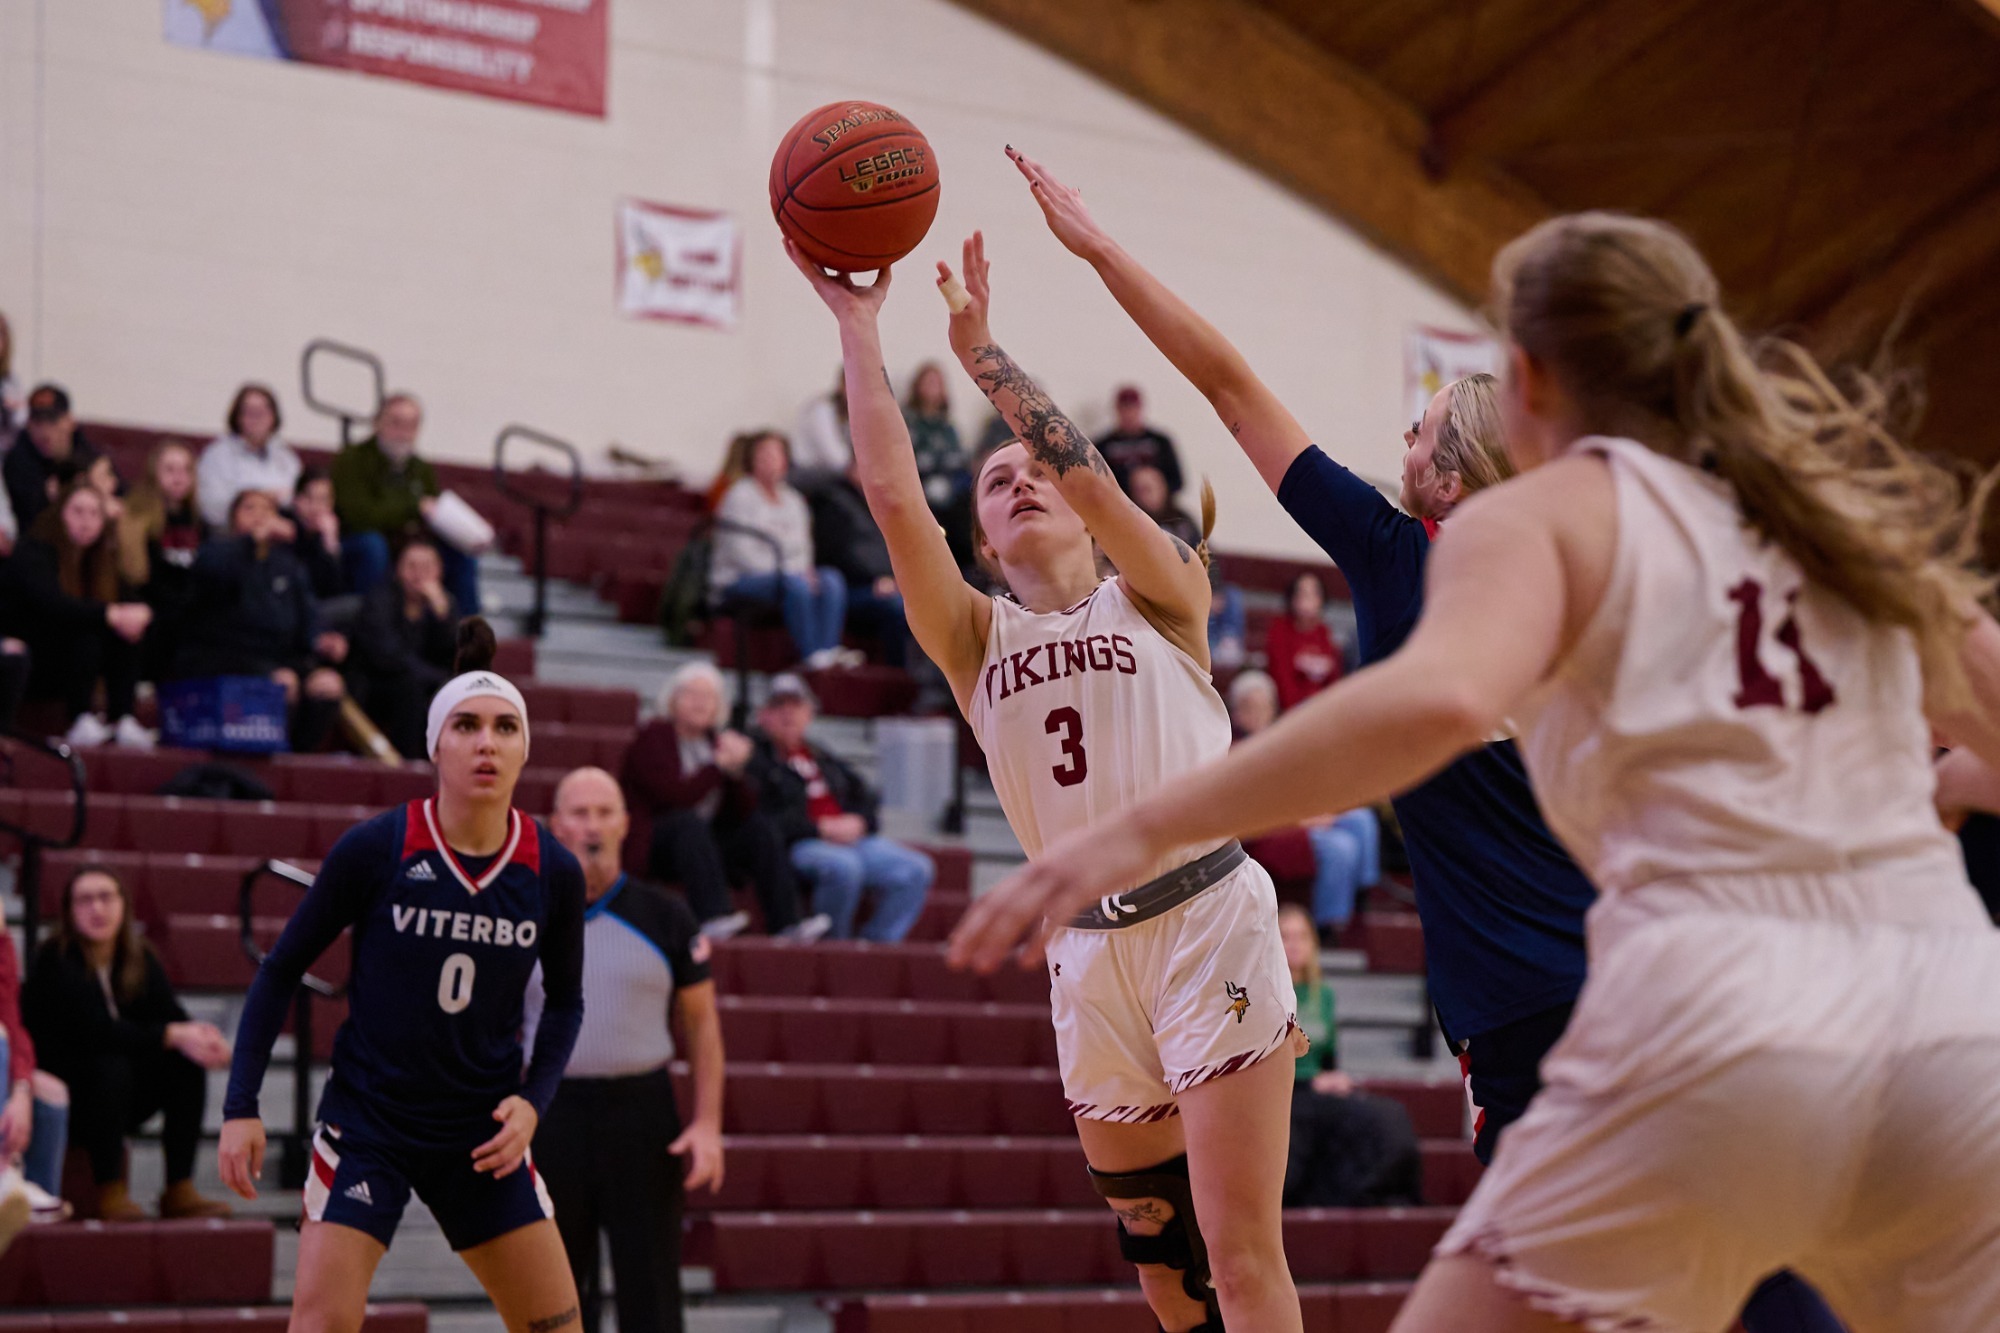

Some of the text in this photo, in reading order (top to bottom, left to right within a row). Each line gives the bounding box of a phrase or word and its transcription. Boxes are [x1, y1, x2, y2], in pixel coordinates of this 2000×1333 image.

[838, 147, 925, 182] LEGACY
[1044, 706, 1087, 787] 3
[392, 903, 538, 948] VITERBO
[437, 952, 476, 1015] 0
